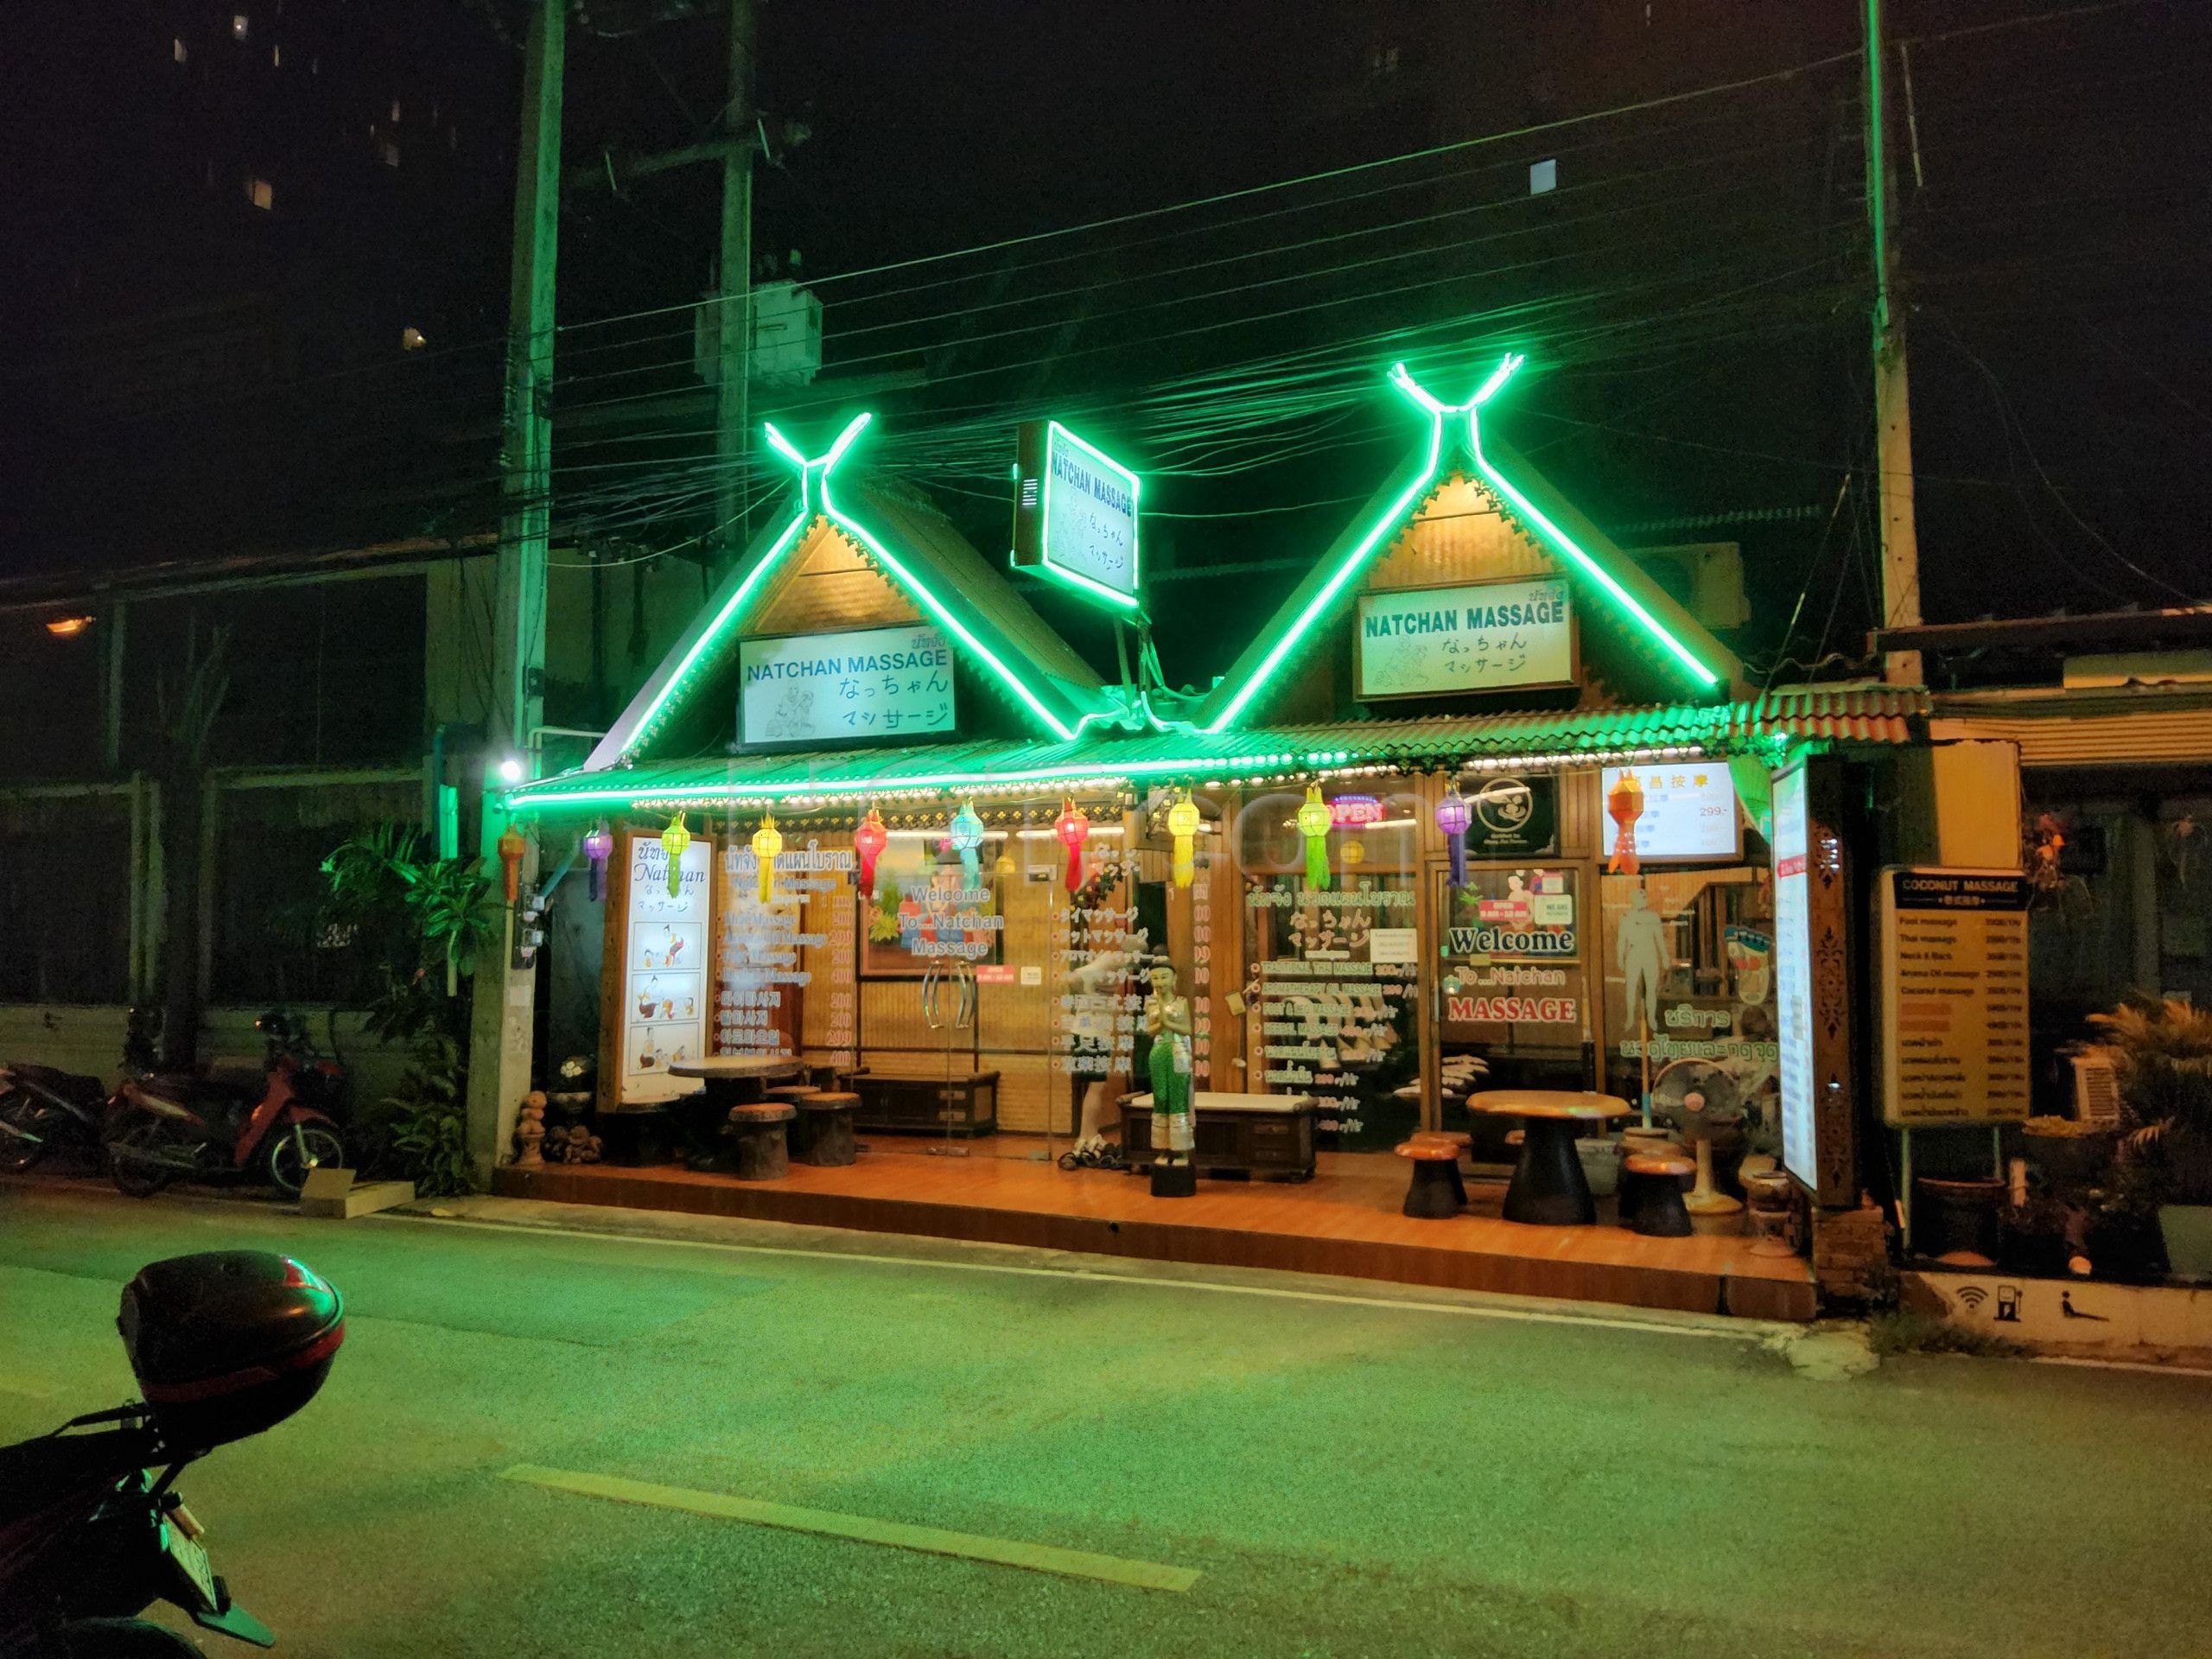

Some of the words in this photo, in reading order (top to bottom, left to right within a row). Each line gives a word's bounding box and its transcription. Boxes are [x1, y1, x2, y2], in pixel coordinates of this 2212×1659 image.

[1052, 453, 1091, 495] NATCHAN
[1094, 477, 1131, 517] MASSAGE
[1365, 610, 1458, 638] NATCHAN
[1467, 602, 1564, 629] MASSAGE
[1442, 632, 1527, 654] なっちゃん
[747, 658, 842, 681] NATCHAN
[848, 650, 948, 673] MASSAGE
[1445, 654, 1527, 673] マッサージ
[840, 670, 948, 699] なっちゃん
[842, 703, 948, 728] マッサージ
[1700, 806, 1727, 817] 299.-
[634, 863, 705, 882] Natan
[912, 887, 990, 902] Welcome
[1903, 880, 1958, 890] COCONUT
[1963, 880, 2018, 892] MASSAGE
[912, 939, 988, 959] Massage
[1450, 928, 1573, 952] Welcome
[1334, 962, 1373, 975] MASSAGE
[1342, 983, 1382, 995] MASSAGE
[1449, 997, 1575, 1021] MASSAGE
